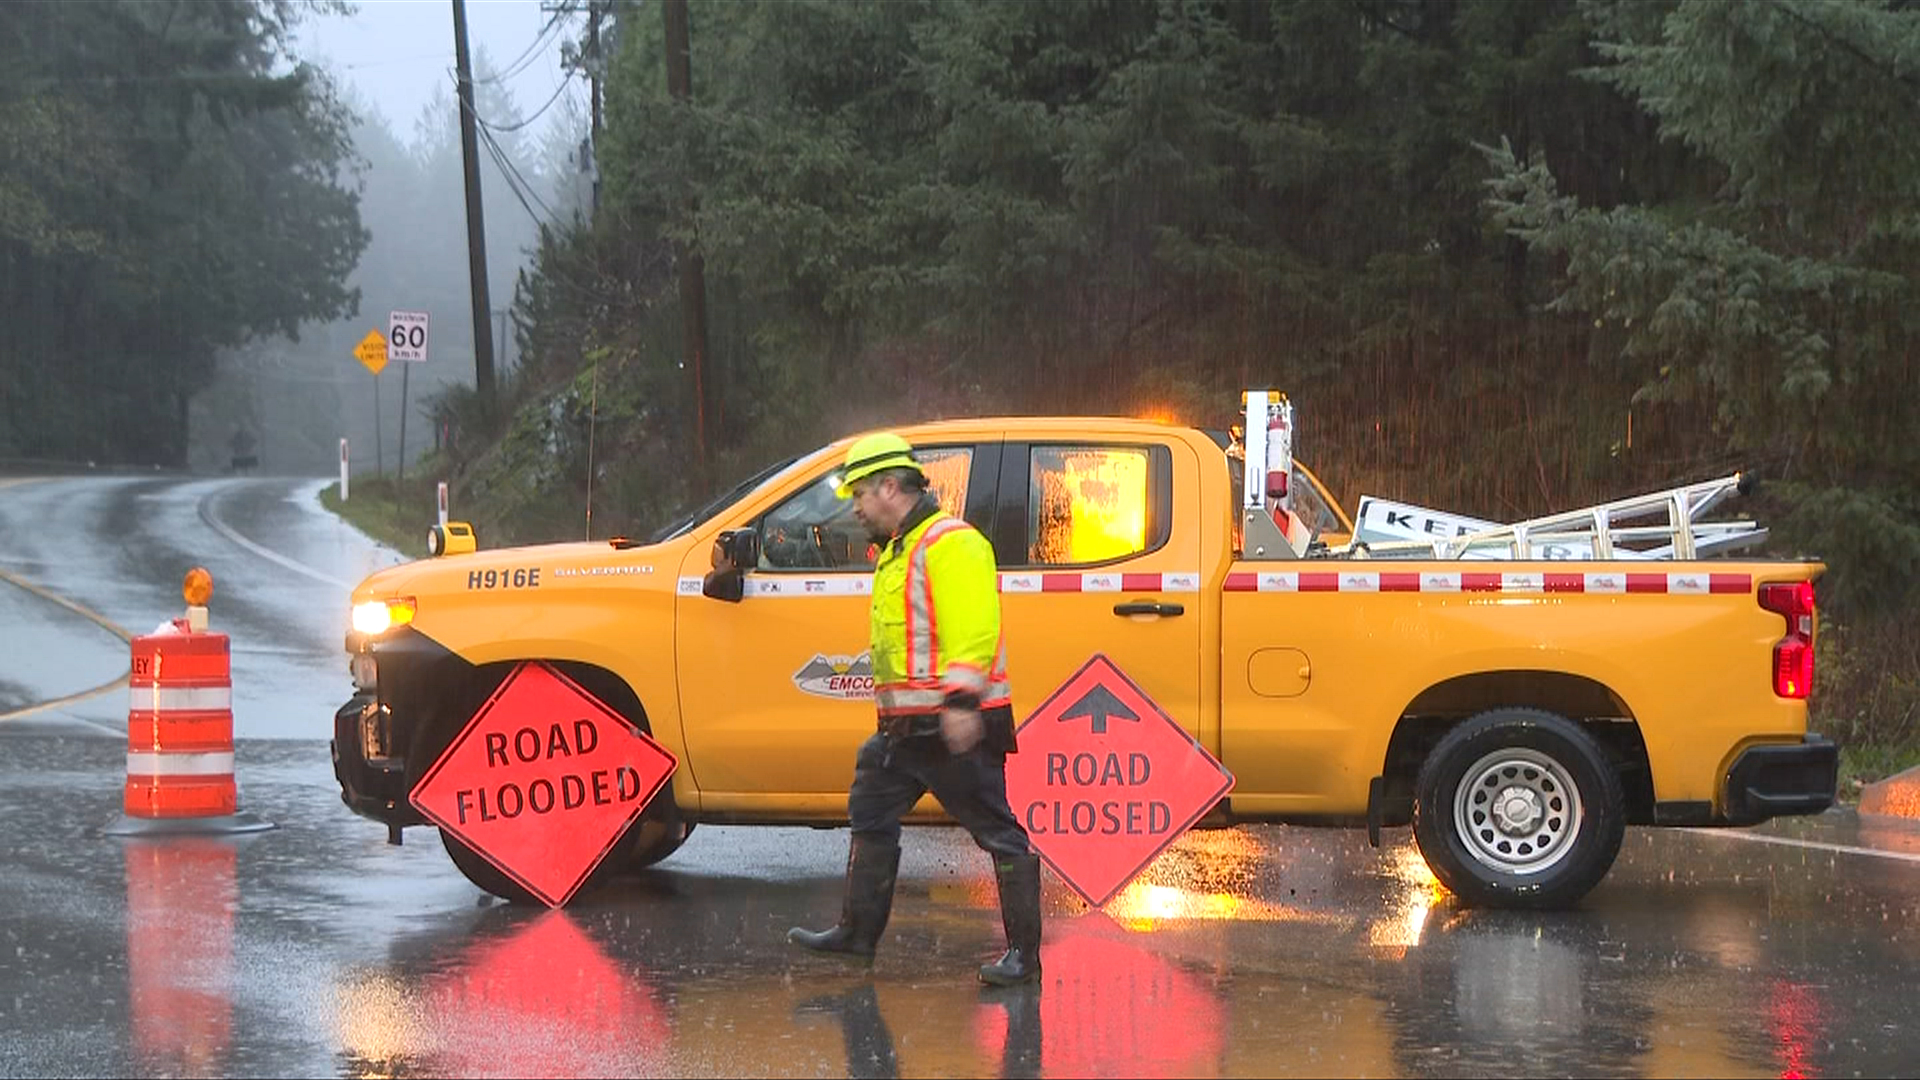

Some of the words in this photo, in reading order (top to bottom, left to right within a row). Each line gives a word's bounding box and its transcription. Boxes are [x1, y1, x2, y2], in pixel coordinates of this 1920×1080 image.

[392, 325, 425, 348] 60
[467, 568, 541, 590] H916E
[554, 565, 655, 577] SILVERADO
[485, 718, 599, 768] ROAD
[1046, 752, 1151, 786] ROAD
[456, 766, 641, 825] FLOODED
[1026, 801, 1171, 835] CLOSED
